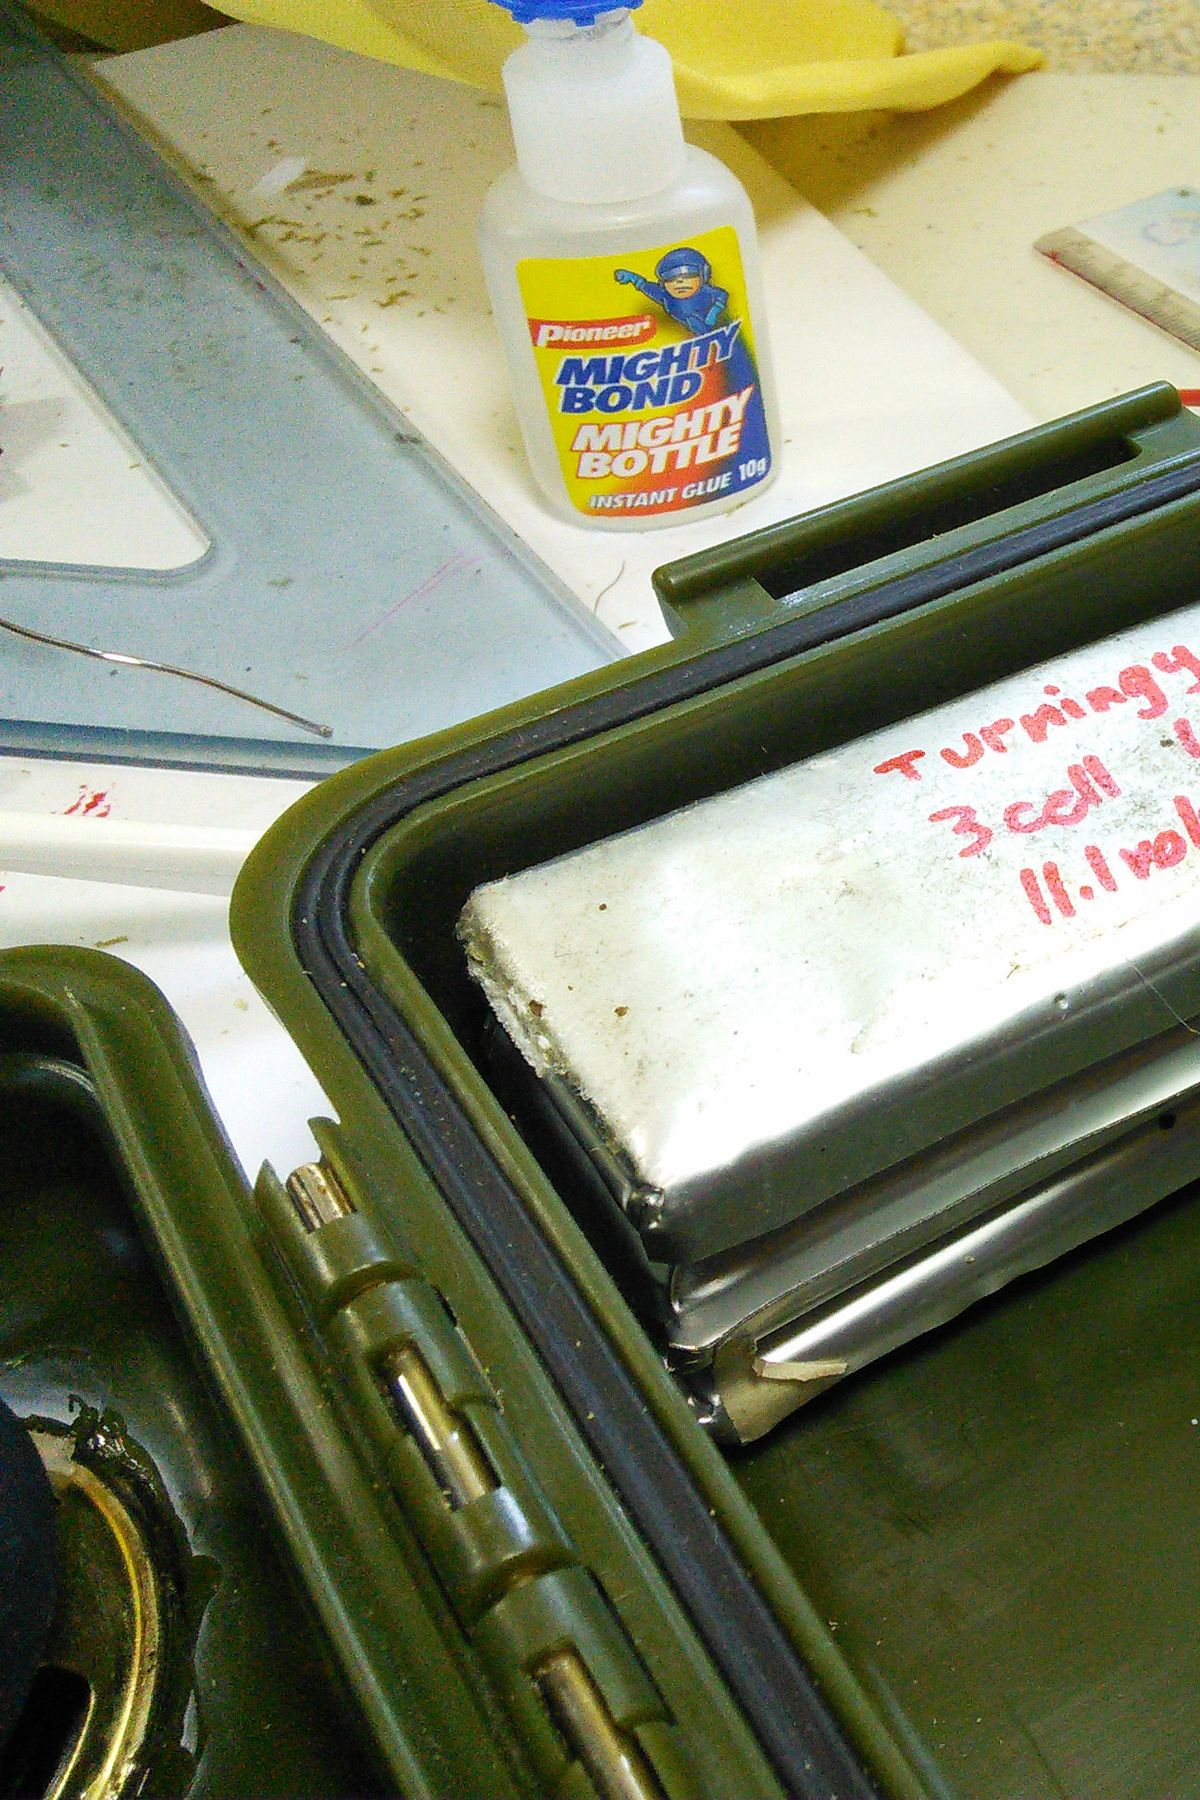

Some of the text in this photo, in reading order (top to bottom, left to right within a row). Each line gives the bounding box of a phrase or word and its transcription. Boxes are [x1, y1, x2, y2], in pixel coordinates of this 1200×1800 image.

[534, 321, 651, 347] Pioneer
[556, 321, 741, 387] MIGHTY
[560, 372, 702, 414] BOND
[572, 384, 754, 451] MIGHTY
[576, 423, 742, 479] BOTTLE
[588, 458, 768, 509] INSTANT GLUE 10g
[928, 805, 993, 858] 3
